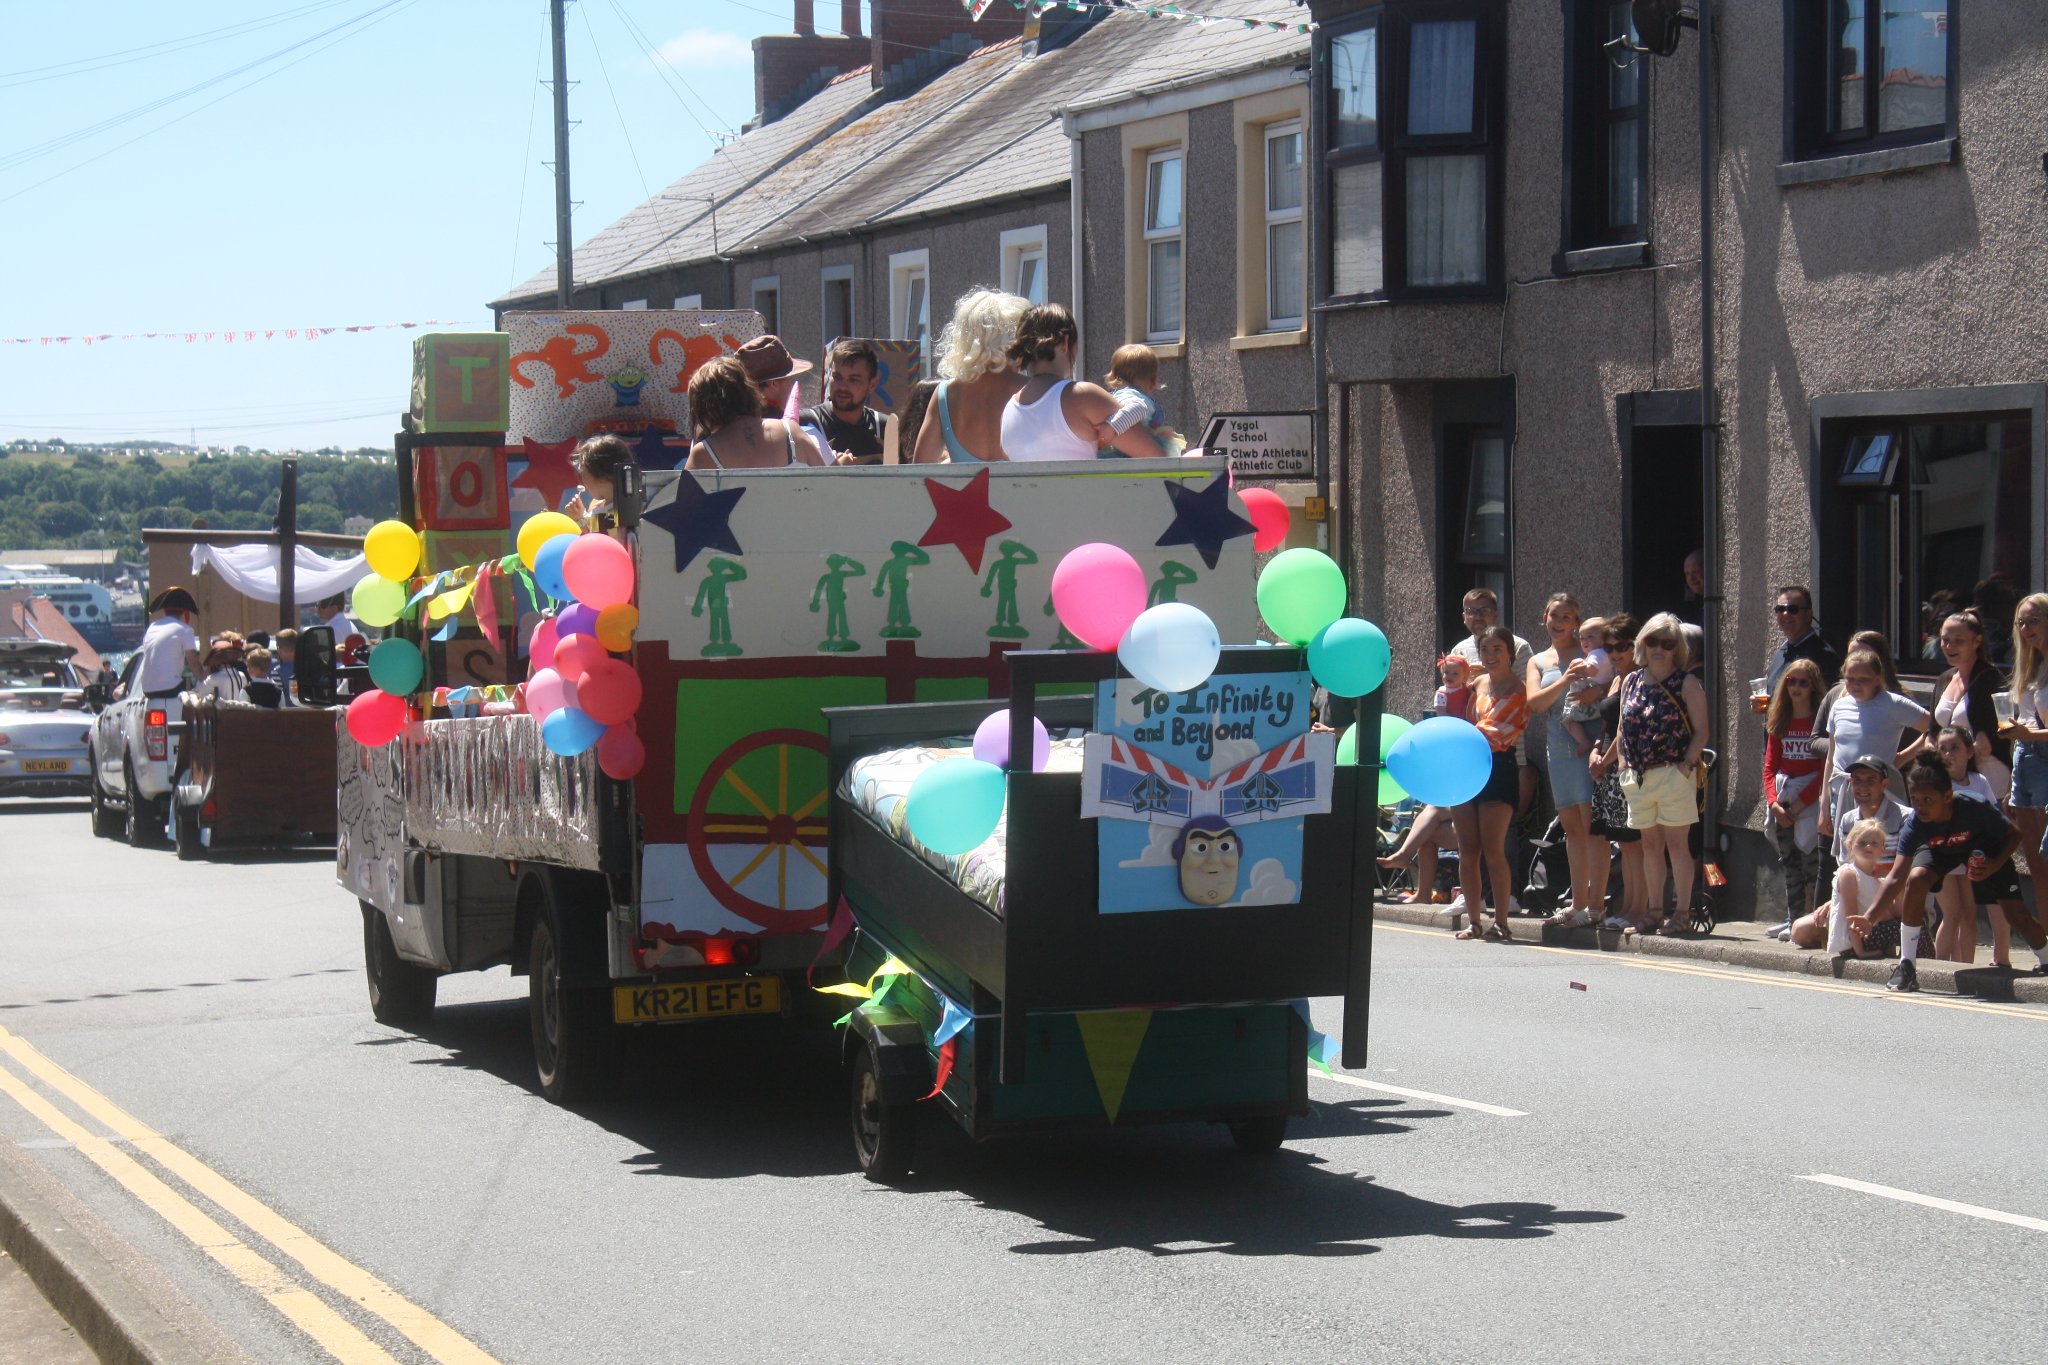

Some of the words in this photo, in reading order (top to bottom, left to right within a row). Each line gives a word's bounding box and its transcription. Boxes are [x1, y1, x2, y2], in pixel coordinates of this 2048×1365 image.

[1230, 420, 1259, 431] Ysgol
[1231, 432, 1268, 442] School
[1231, 448, 1259, 458] Clwb
[1262, 448, 1308, 458] Athletau
[1231, 460, 1274, 470] Athletic
[1277, 459, 1303, 469] Club
[1132, 687, 1170, 718] To
[1176, 680, 1295, 727] Infinity
[1133, 721, 1164, 742] and
[1171, 717, 1255, 762] Beyond
[25, 761, 67, 770] NEYLAND
[632, 986, 698, 1016] KR21
[707, 982, 763, 1011] EFG
